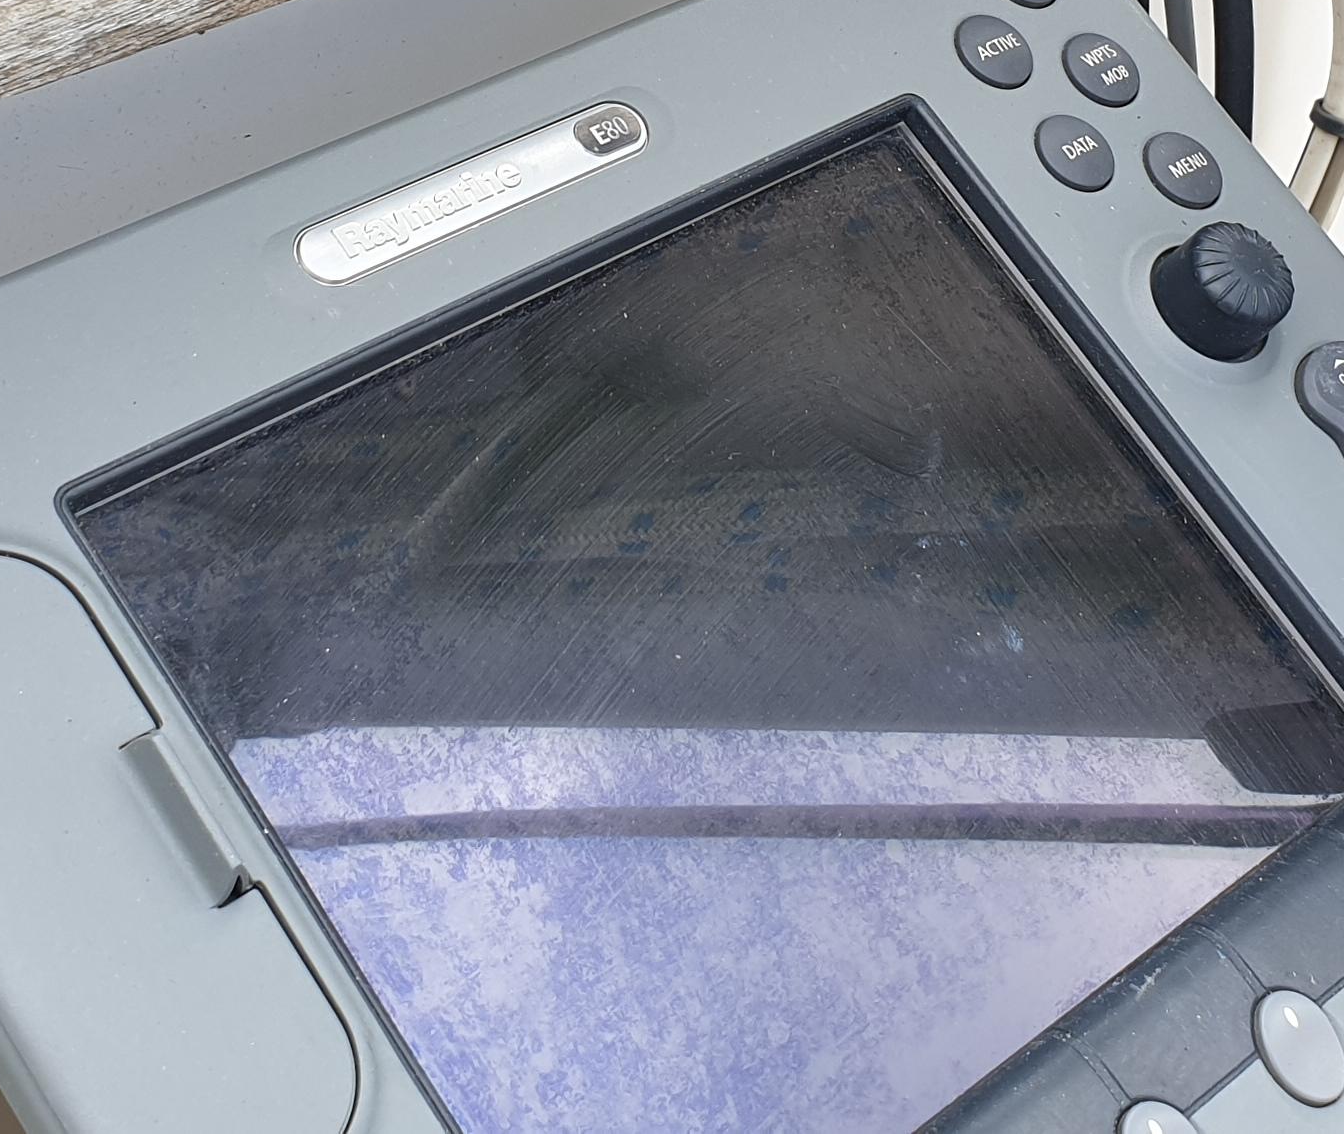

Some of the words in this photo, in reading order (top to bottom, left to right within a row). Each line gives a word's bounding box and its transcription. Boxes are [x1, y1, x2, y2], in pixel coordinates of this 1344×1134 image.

[977, 32, 1022, 61] ACTIVE
[1080, 44, 1117, 68] WPTS
[1101, 65, 1129, 87] MOB
[589, 115, 629, 146] E80
[1062, 134, 1098, 161] DATA
[1167, 151, 1208, 179] MENU
[330, 160, 523, 260] Raymarine
